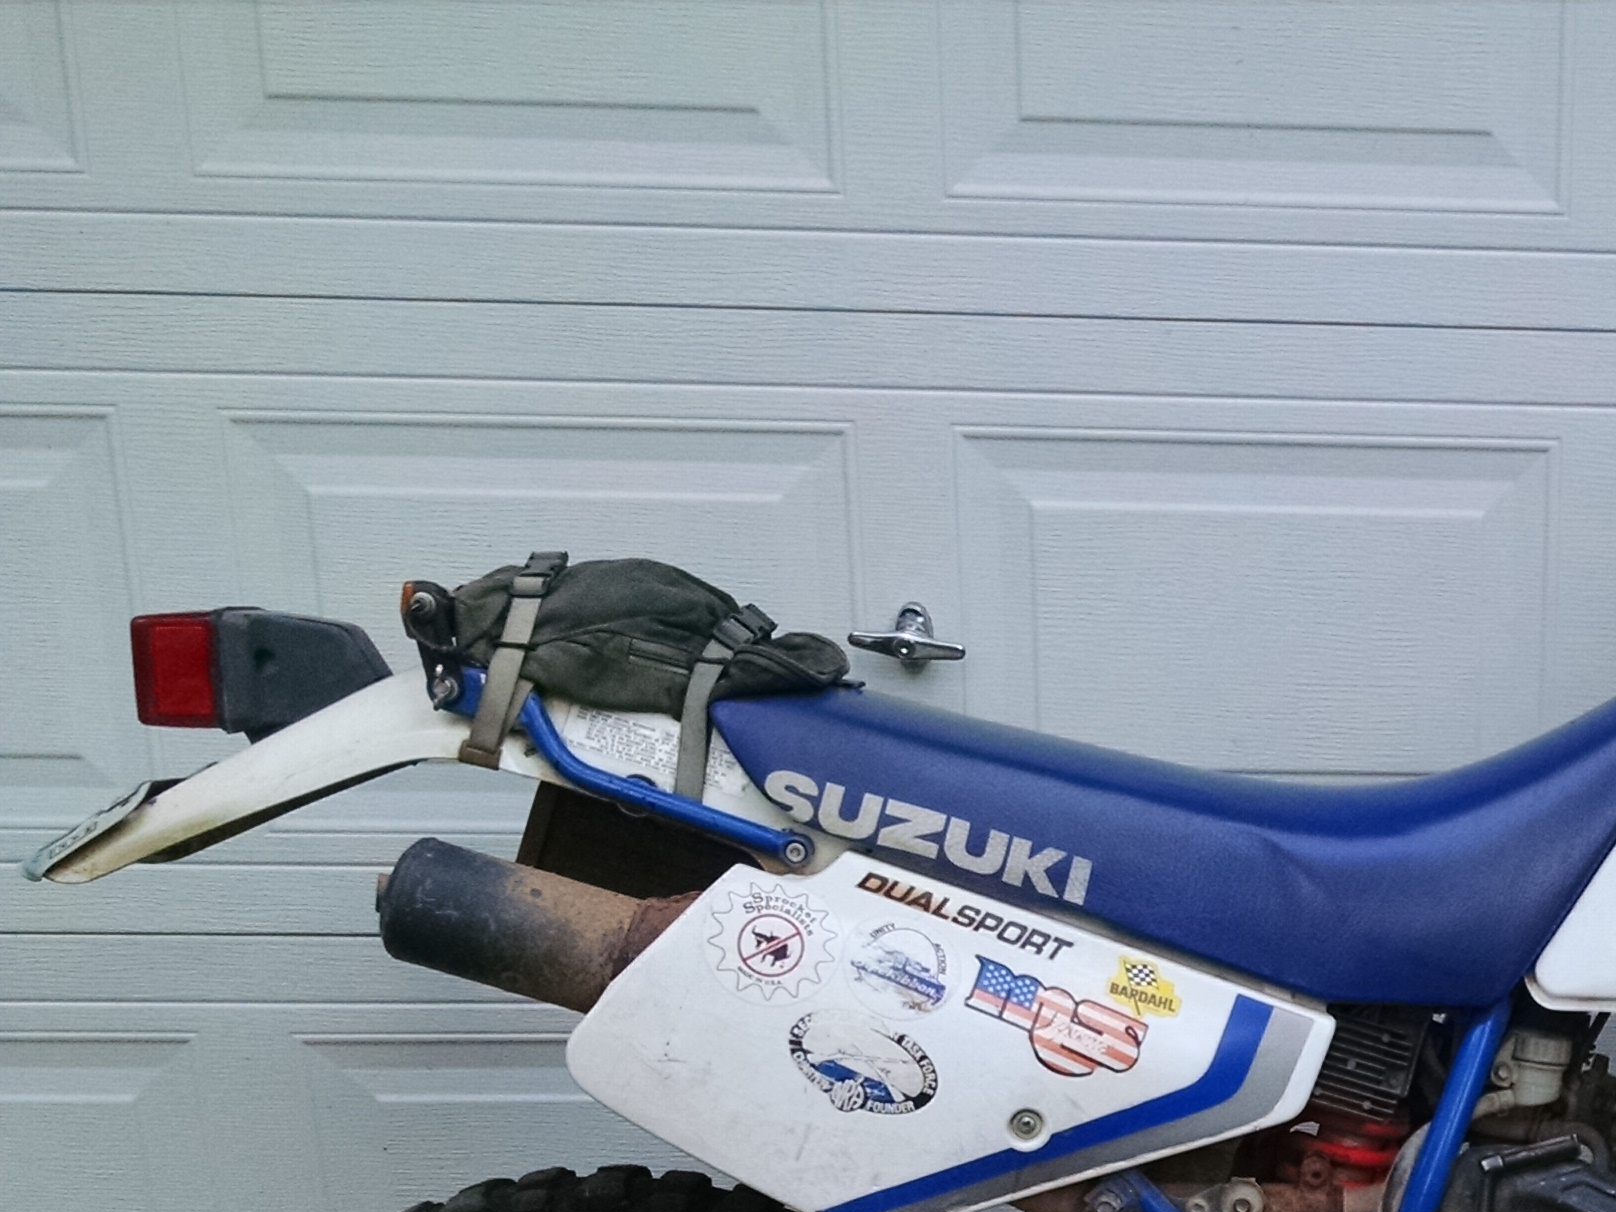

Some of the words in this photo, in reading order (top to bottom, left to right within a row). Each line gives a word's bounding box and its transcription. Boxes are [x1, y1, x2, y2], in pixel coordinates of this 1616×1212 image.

[763, 770, 1093, 906] SUZUKI
[742, 902, 814, 937] Specialists
[751, 892, 818, 924] Sprocket
[855, 872, 1073, 961] DUALSPORT
[869, 923, 896, 939] UNITY
[1109, 981, 1177, 1013] BARDAHL
[901, 1036, 924, 1061] TASK
[918, 1056, 938, 1096] FORCE
[865, 1100, 917, 1115] FOUNDER
